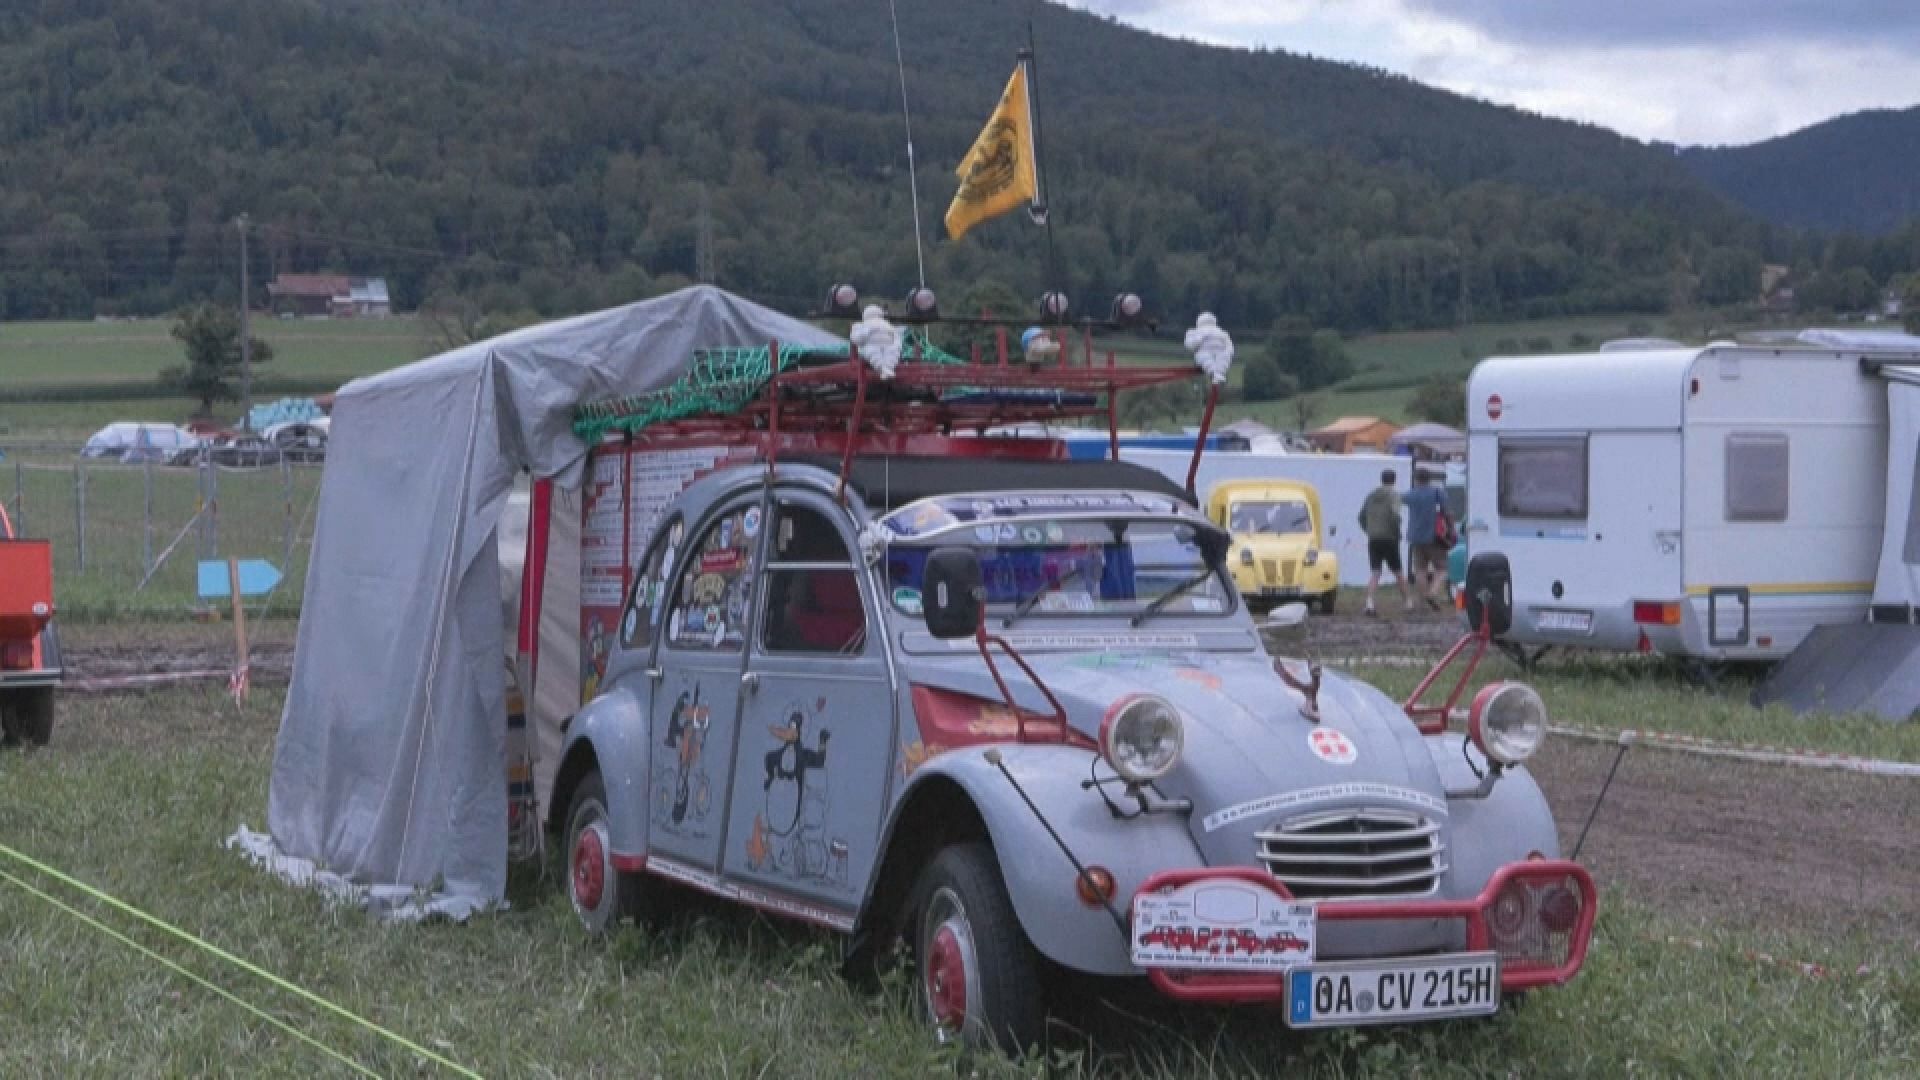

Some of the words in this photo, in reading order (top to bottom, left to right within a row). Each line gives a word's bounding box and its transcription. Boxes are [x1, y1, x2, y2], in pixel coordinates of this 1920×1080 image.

[1315, 975, 1353, 1014] OA
[1378, 971, 1415, 1010] CV
[1423, 966, 1491, 1008] 215H
